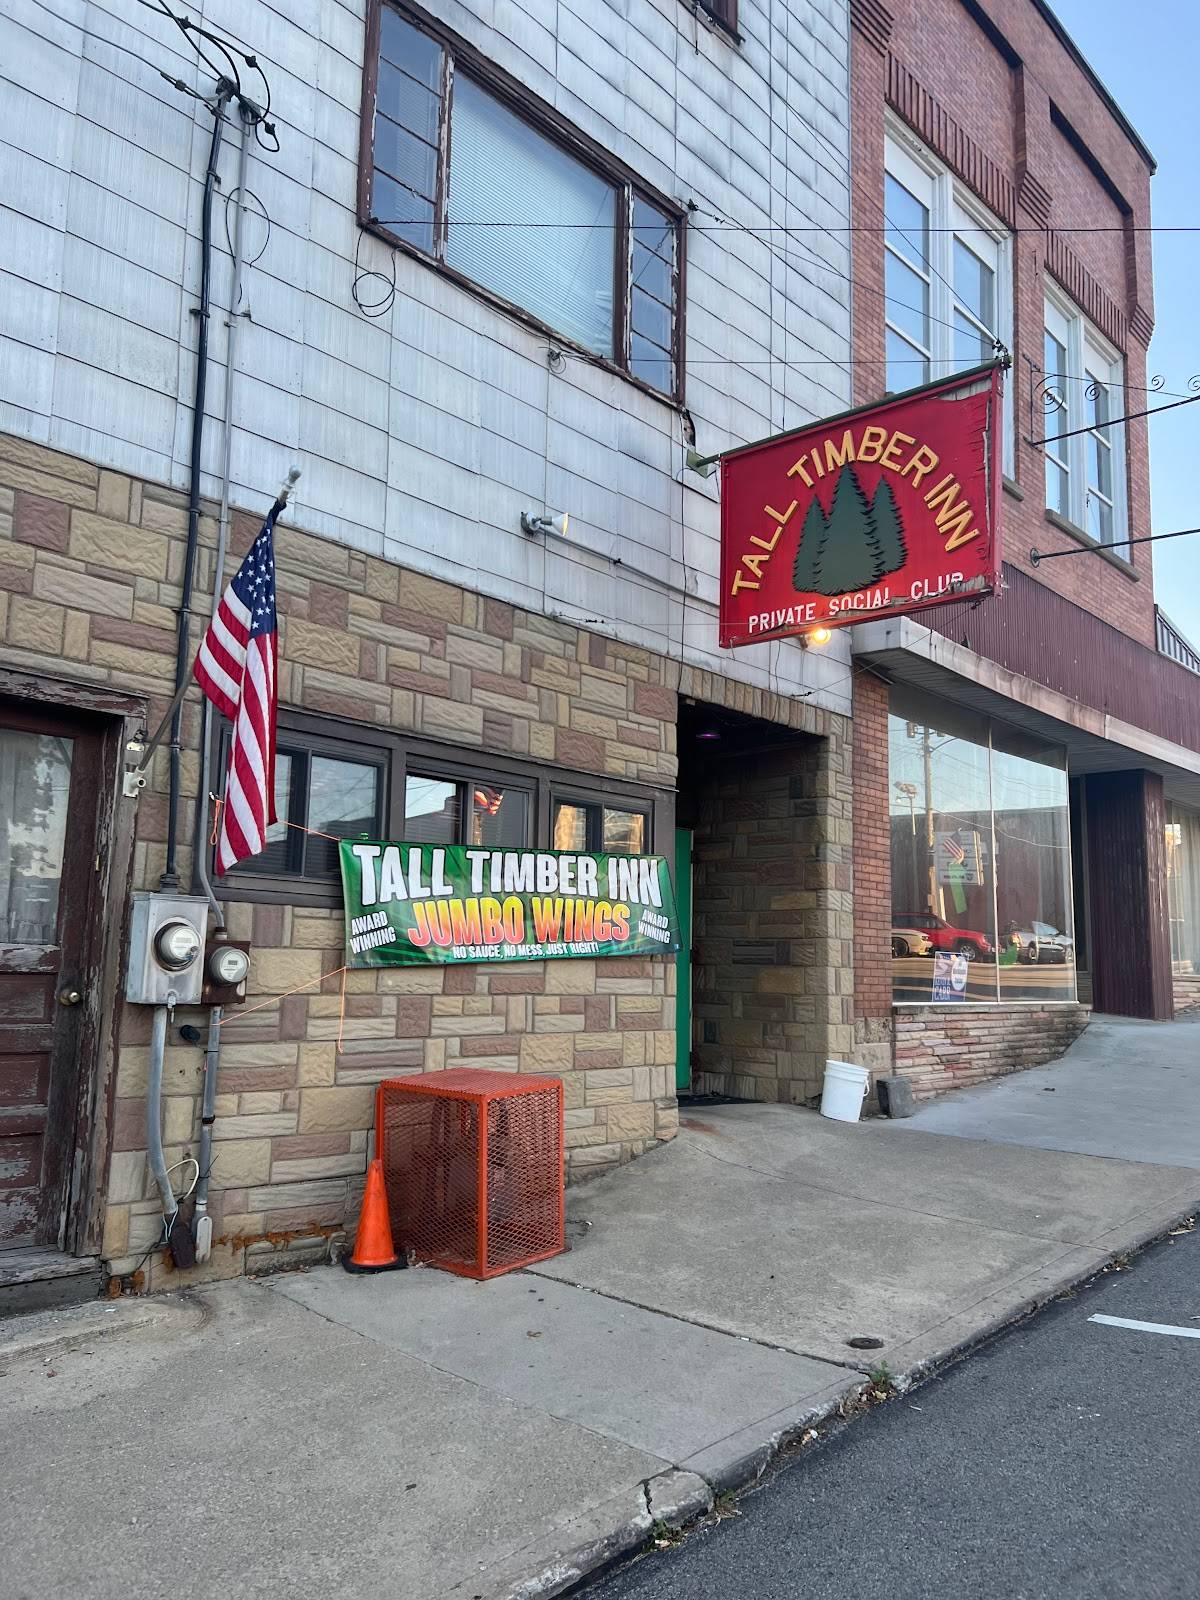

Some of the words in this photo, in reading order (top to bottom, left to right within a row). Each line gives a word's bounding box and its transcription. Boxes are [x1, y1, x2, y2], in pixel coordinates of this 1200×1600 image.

[731, 500, 798, 596] TALL
[787, 426, 940, 488] TIMBER
[924, 473, 980, 552] INN
[748, 602, 816, 633] PRIVATE
[828, 587, 891, 616] SOCIAL
[352, 844, 453, 906] TALL
[466, 850, 599, 896] TIMBER
[608, 857, 663, 907] INN
[351, 910, 388, 936] AWARD
[407, 895, 525, 947] JUMBO
[532, 896, 631, 943] WINGS
[638, 920, 671, 944] WINNING
[641, 909, 669, 929] AWARD
[350, 926, 397, 954] WINNING
[453, 946, 467, 958] NO
[469, 945, 503, 959] SAUCE,
[505, 945, 516, 957] NO
[517, 944, 545, 957] MESS,
[546, 944, 568, 955] JUST
[570, 942, 600, 954] RIGHT!
